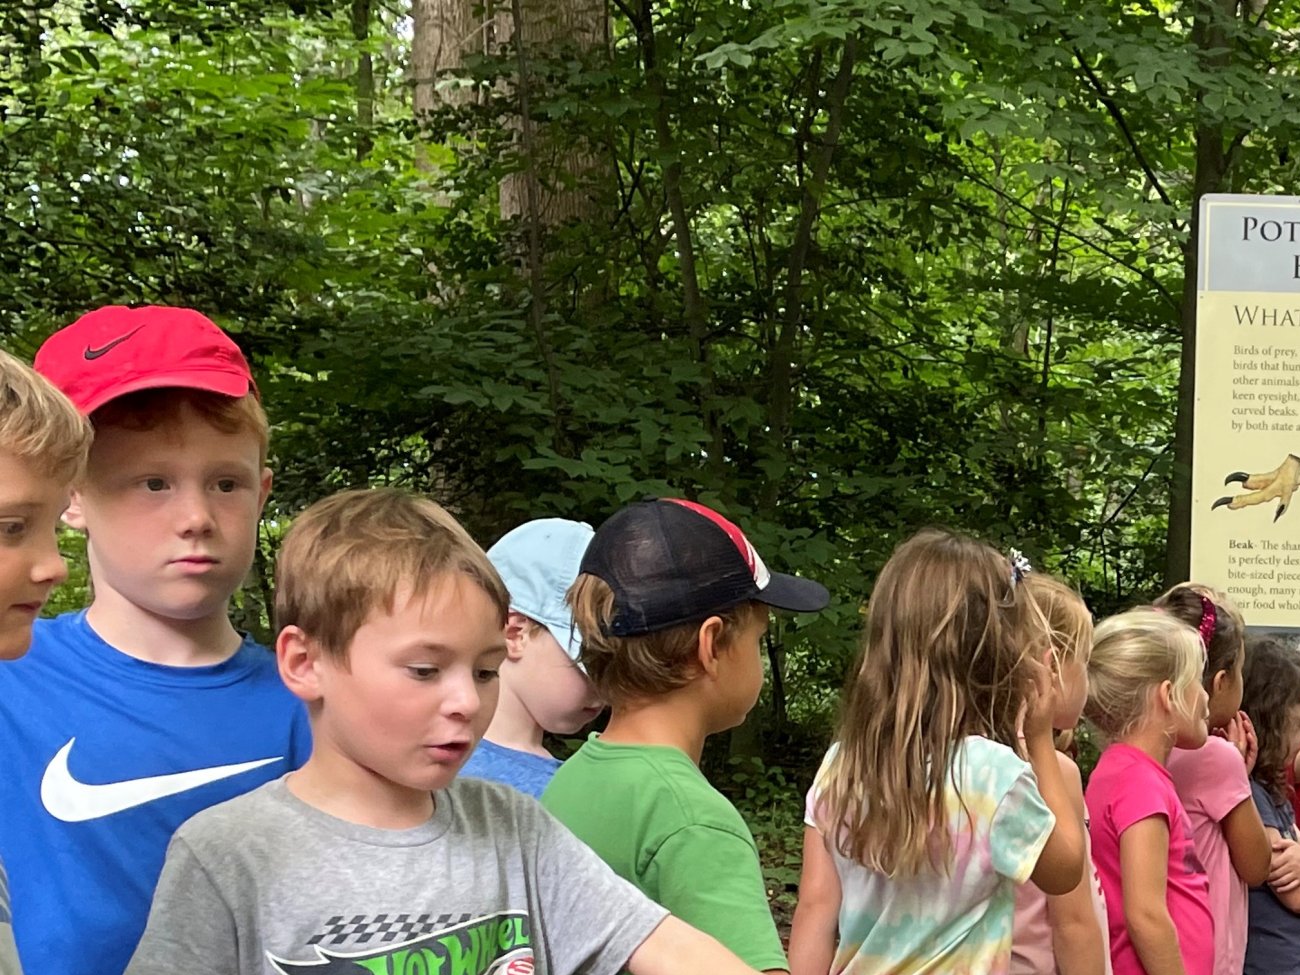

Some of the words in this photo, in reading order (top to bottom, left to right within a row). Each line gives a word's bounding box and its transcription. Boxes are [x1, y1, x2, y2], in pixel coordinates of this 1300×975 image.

[1234, 345, 1259, 355] Birds
[1262, 346, 1273, 356] of
[1274, 348, 1296, 359] prey,
[1233, 360, 1258, 370] birds
[1260, 362, 1279, 371] that
[1233, 376, 1259, 386] other
[1233, 390, 1255, 400] keen
[1232, 406, 1265, 416] curved
[1232, 421, 1243, 432] by
[1246, 421, 1268, 431] both
[1271, 423, 1294, 431] state
[1260, 540, 1279, 550] The
[1228, 555, 1236, 564] is
[1239, 556, 1281, 567] perfectly
[1228, 569, 1274, 579] bite-sized
[1270, 588, 1297, 597] many
[1253, 600, 1275, 609] food
